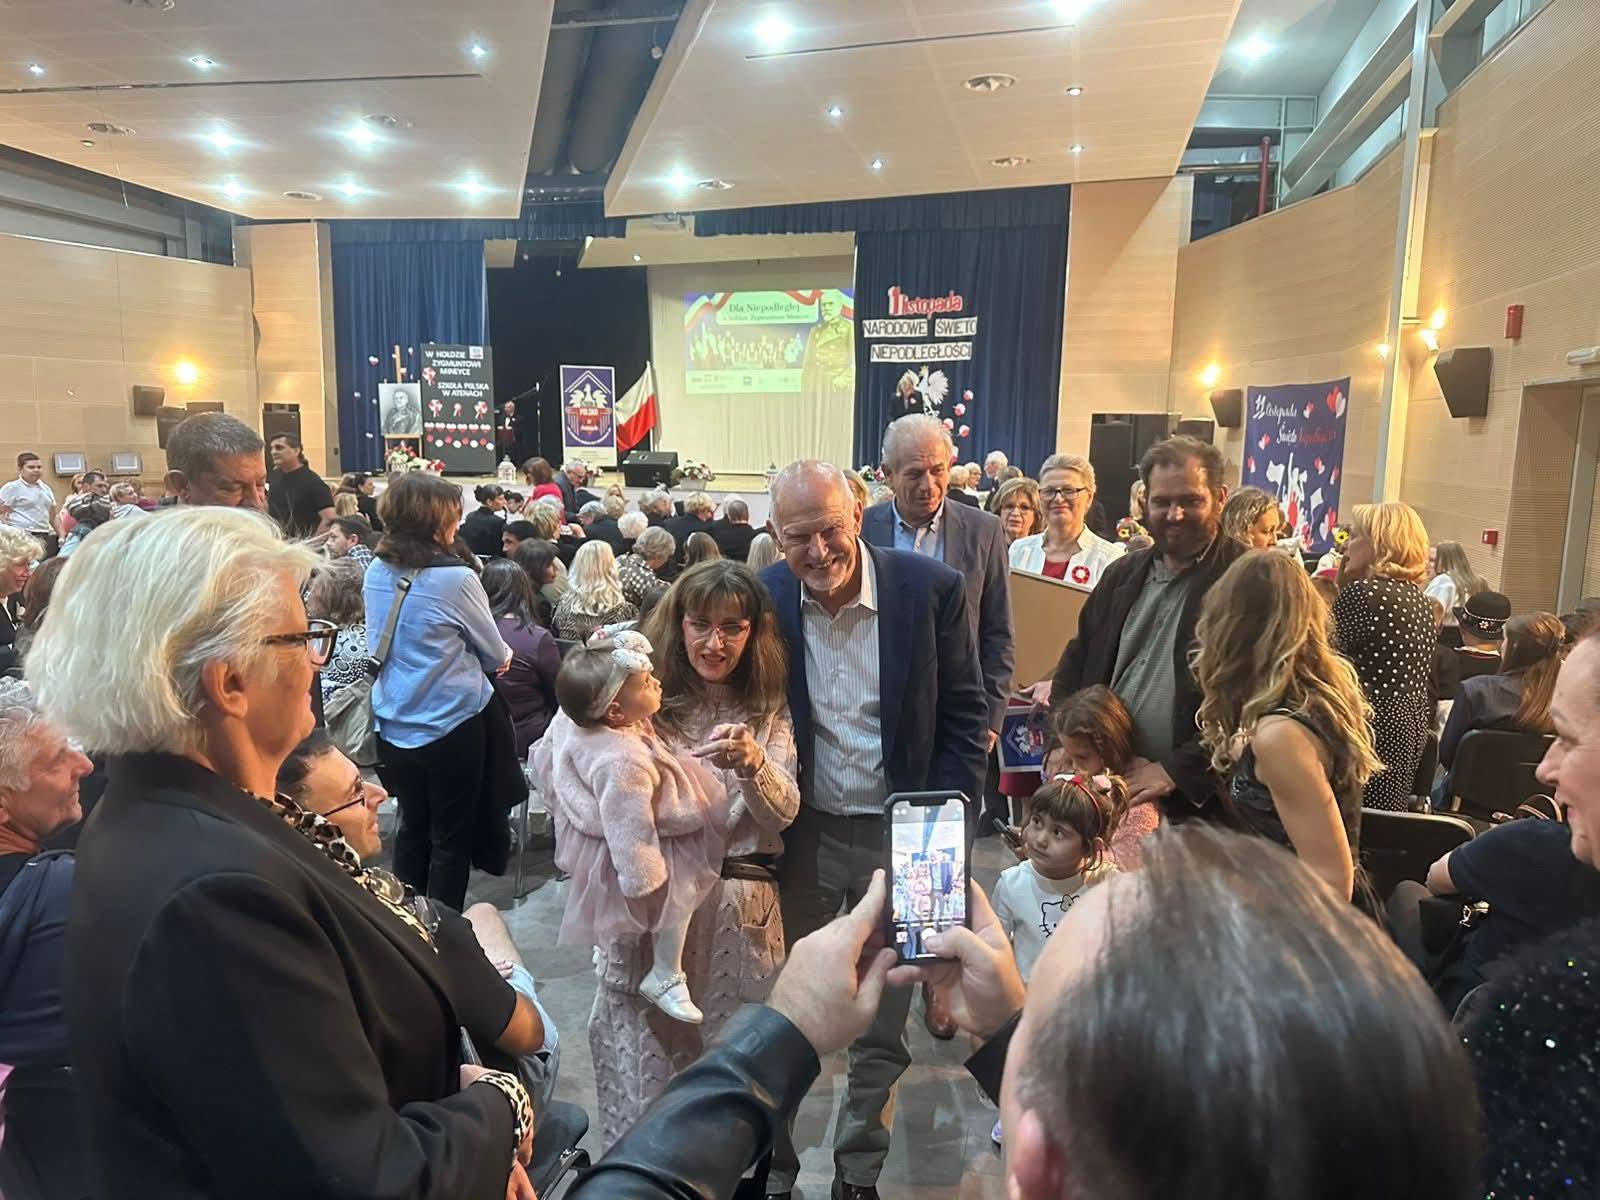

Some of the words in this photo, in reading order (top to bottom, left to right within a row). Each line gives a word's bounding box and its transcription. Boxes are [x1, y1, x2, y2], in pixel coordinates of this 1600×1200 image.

[729, 303, 744, 313] Dla
[862, 320, 928, 335] NARODOWE
[425, 350, 434, 358] W
[871, 343, 971, 361] NIEPODLEGŁOŚCI
[431, 359, 482, 368] ZYGMUNTOWI
[463, 382, 490, 391] POLSKA
[451, 390, 483, 398] ATENACH
